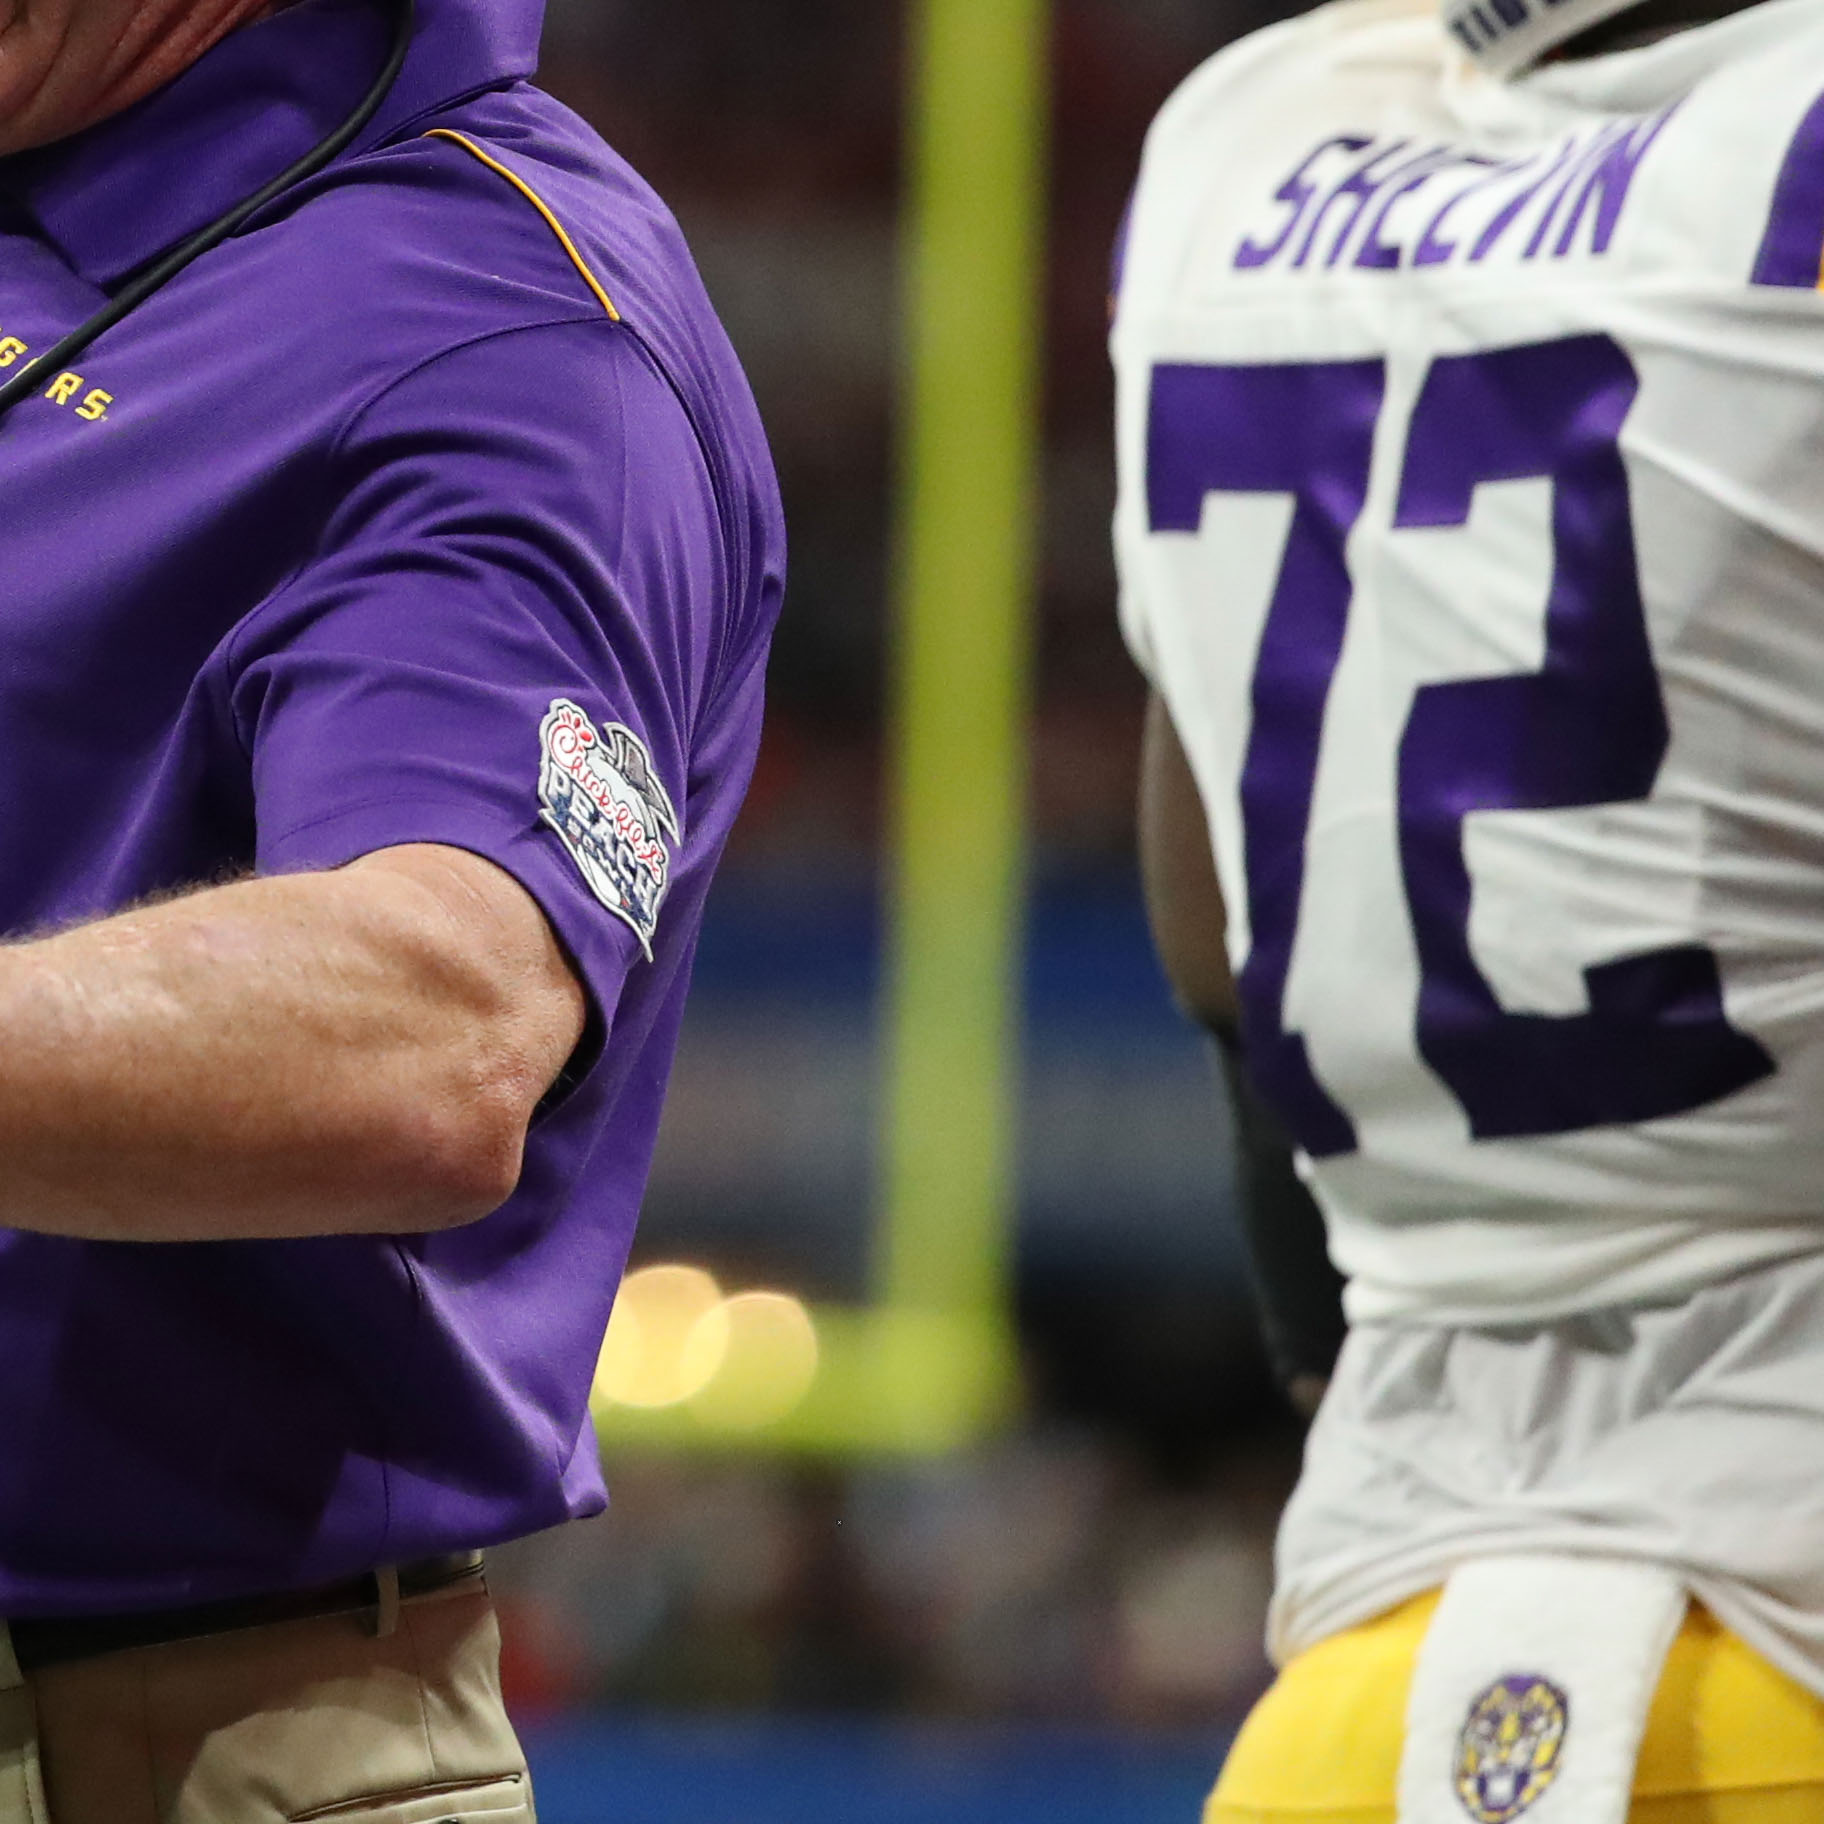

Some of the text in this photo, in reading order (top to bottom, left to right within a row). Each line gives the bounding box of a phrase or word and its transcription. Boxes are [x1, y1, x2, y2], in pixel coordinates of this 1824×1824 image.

[1233, 93, 1692, 269] SHELVIN
[549, 714, 663, 880] Chick-fil-A
[1146, 332, 1777, 1157] 72
[548, 761, 657, 916] PEACH
